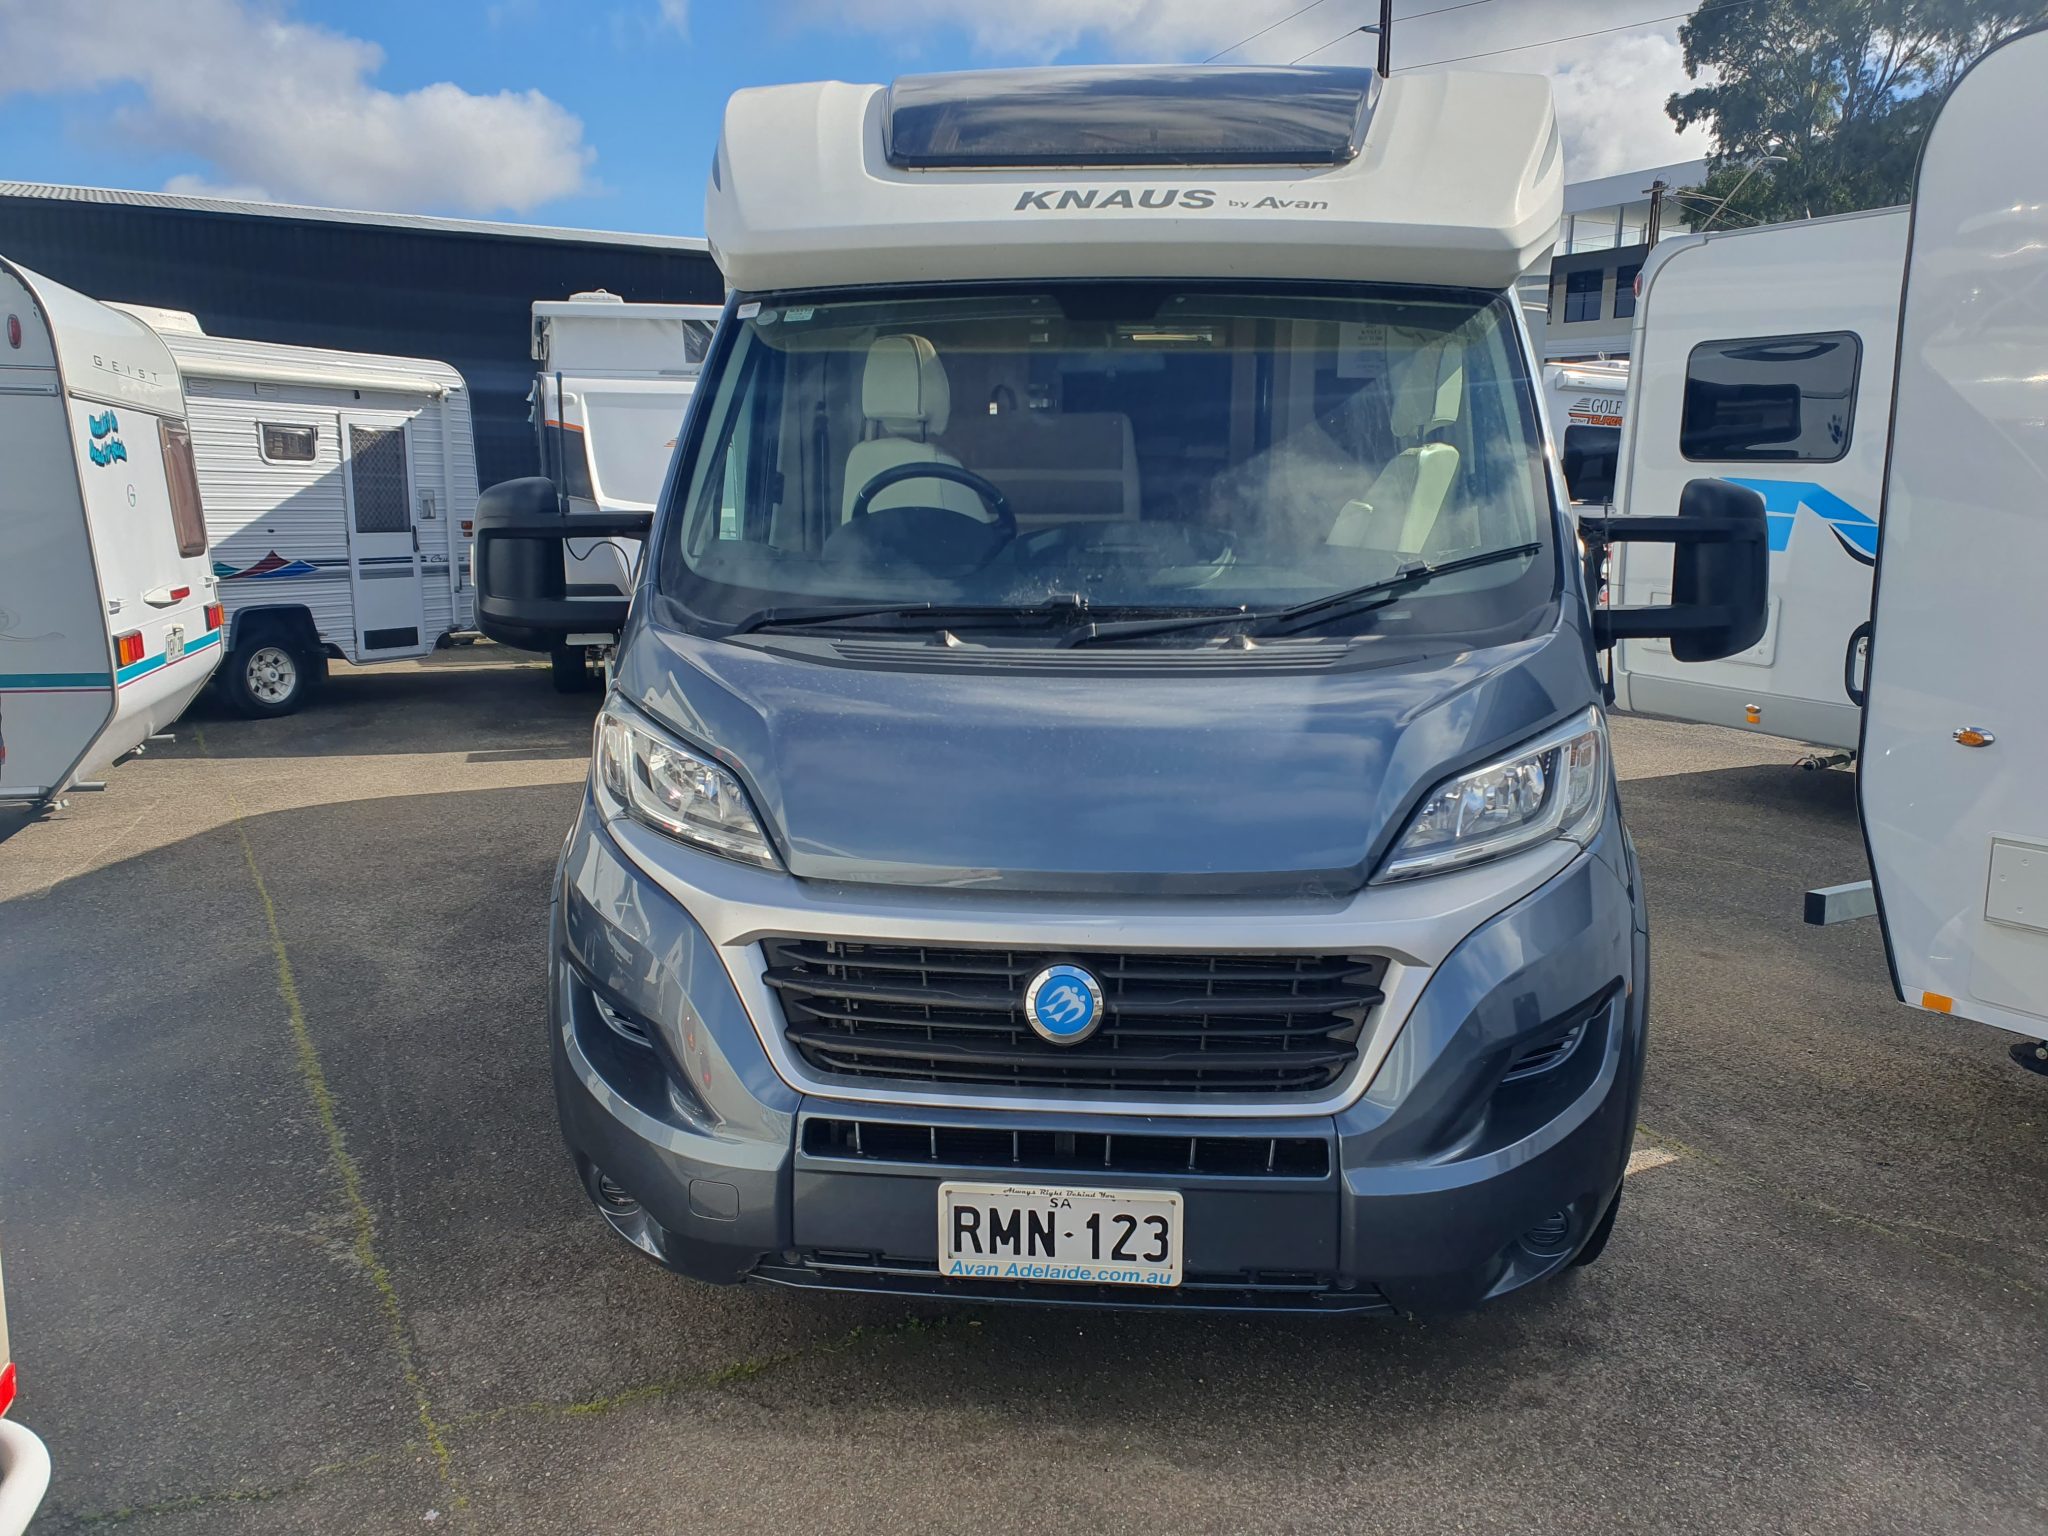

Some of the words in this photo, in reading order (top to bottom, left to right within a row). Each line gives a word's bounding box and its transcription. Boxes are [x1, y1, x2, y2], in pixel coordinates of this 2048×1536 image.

[1013, 189, 1217, 211] KNAUS
[1229, 199, 1249, 210] by
[1251, 196, 1329, 210] Avan
[93, 354, 158, 383] GEIST
[1591, 398, 1623, 415] GOLF
[1003, 1187, 1036, 1196] Always
[1039, 1188, 1063, 1198] Right
[1066, 1189, 1096, 1198] Behind
[1098, 1191, 1116, 1199] You
[1049, 1198, 1072, 1209] SA
[950, 1260, 999, 1277] Avan
[1004, 1262, 1172, 1285] Adelaide.com.au
